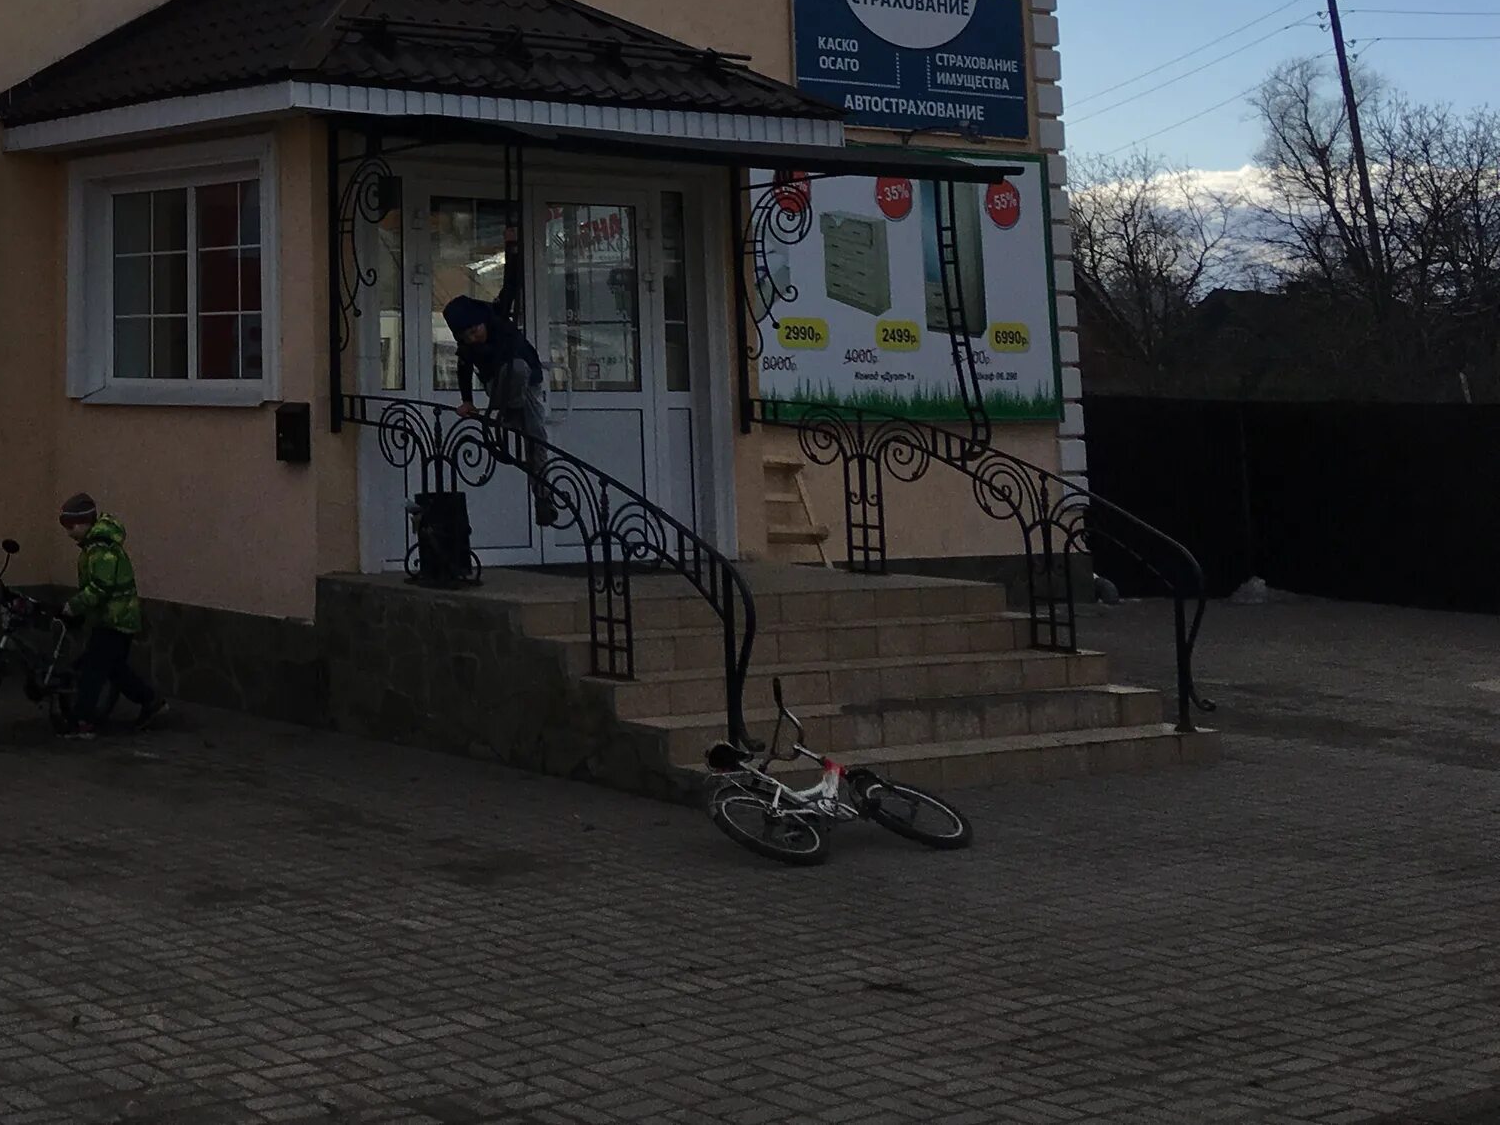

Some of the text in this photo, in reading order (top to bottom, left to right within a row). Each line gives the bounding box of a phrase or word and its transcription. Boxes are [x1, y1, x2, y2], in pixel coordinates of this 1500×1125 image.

[818, 36, 858, 53] КАСКО
[819, 55, 860, 72] ОСАГО
[935, 52, 1019, 73] СТРАХОВАНИЕ
[936, 72, 1010, 91] ИМУЩЕСТВА
[844, 94, 985, 121] АВТОСТРАХОВАНИЕ
[994, 192, 1017, 209] 55%
